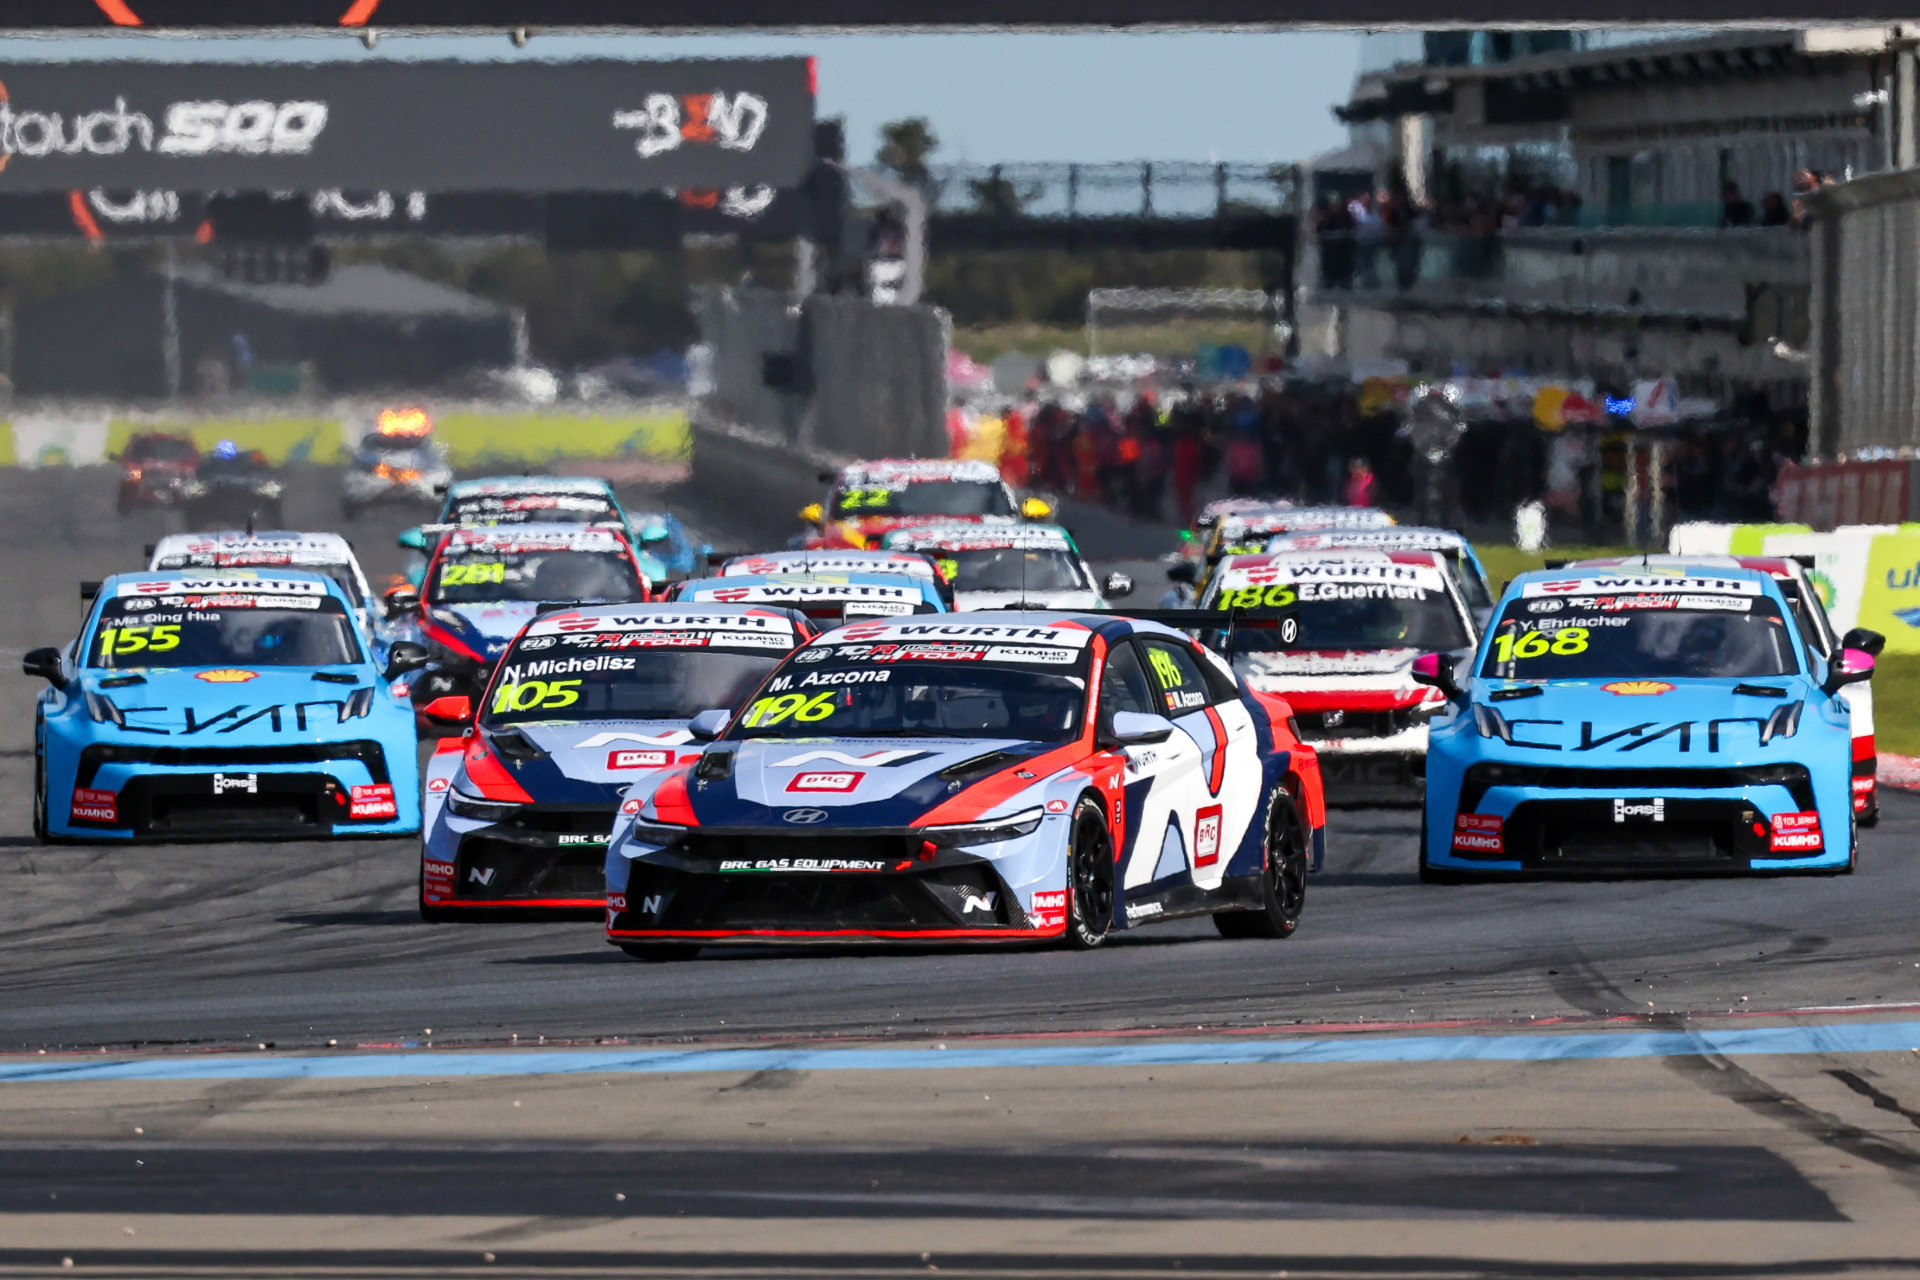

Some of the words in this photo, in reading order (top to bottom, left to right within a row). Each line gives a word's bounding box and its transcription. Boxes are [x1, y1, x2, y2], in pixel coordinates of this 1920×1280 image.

[1218, 584, 1297, 611] 186
[114, 615, 139, 627] Ma
[143, 612, 183, 625] Qing
[187, 611, 220, 621] Hua
[1538, 615, 1630, 629] Ehrlacher
[100, 625, 181, 656] 155
[636, 638, 702, 646] TOUR
[1495, 627, 1590, 662] 168
[909, 651, 978, 660] TOUR
[1000, 649, 1068, 657] KUMHO
[504, 656, 635, 681] N.Michelisz
[1149, 651, 1182, 689] 196
[769, 676, 793, 692] M.
[803, 669, 890, 686] Azcona
[492, 679, 582, 714] 105
[743, 691, 836, 729] 196
[623, 752, 663, 762] BRC
[214, 773, 258, 794] HORSE
[806, 775, 846, 785] BRC
[73, 807, 115, 819] KUMHO
[352, 802, 396, 815] KUMHO
[1614, 798, 1664, 822] HORSE
[558, 834, 589, 844] BRC
[593, 834, 612, 843] GA
[1199, 823, 1216, 843] BRC
[1774, 834, 1820, 846] KUMHO
[1455, 835, 1501, 848] KUMHO
[720, 860, 752, 869] BRC
[755, 859, 789, 868] GAS
[793, 859, 885, 869] EQUIPMENT
